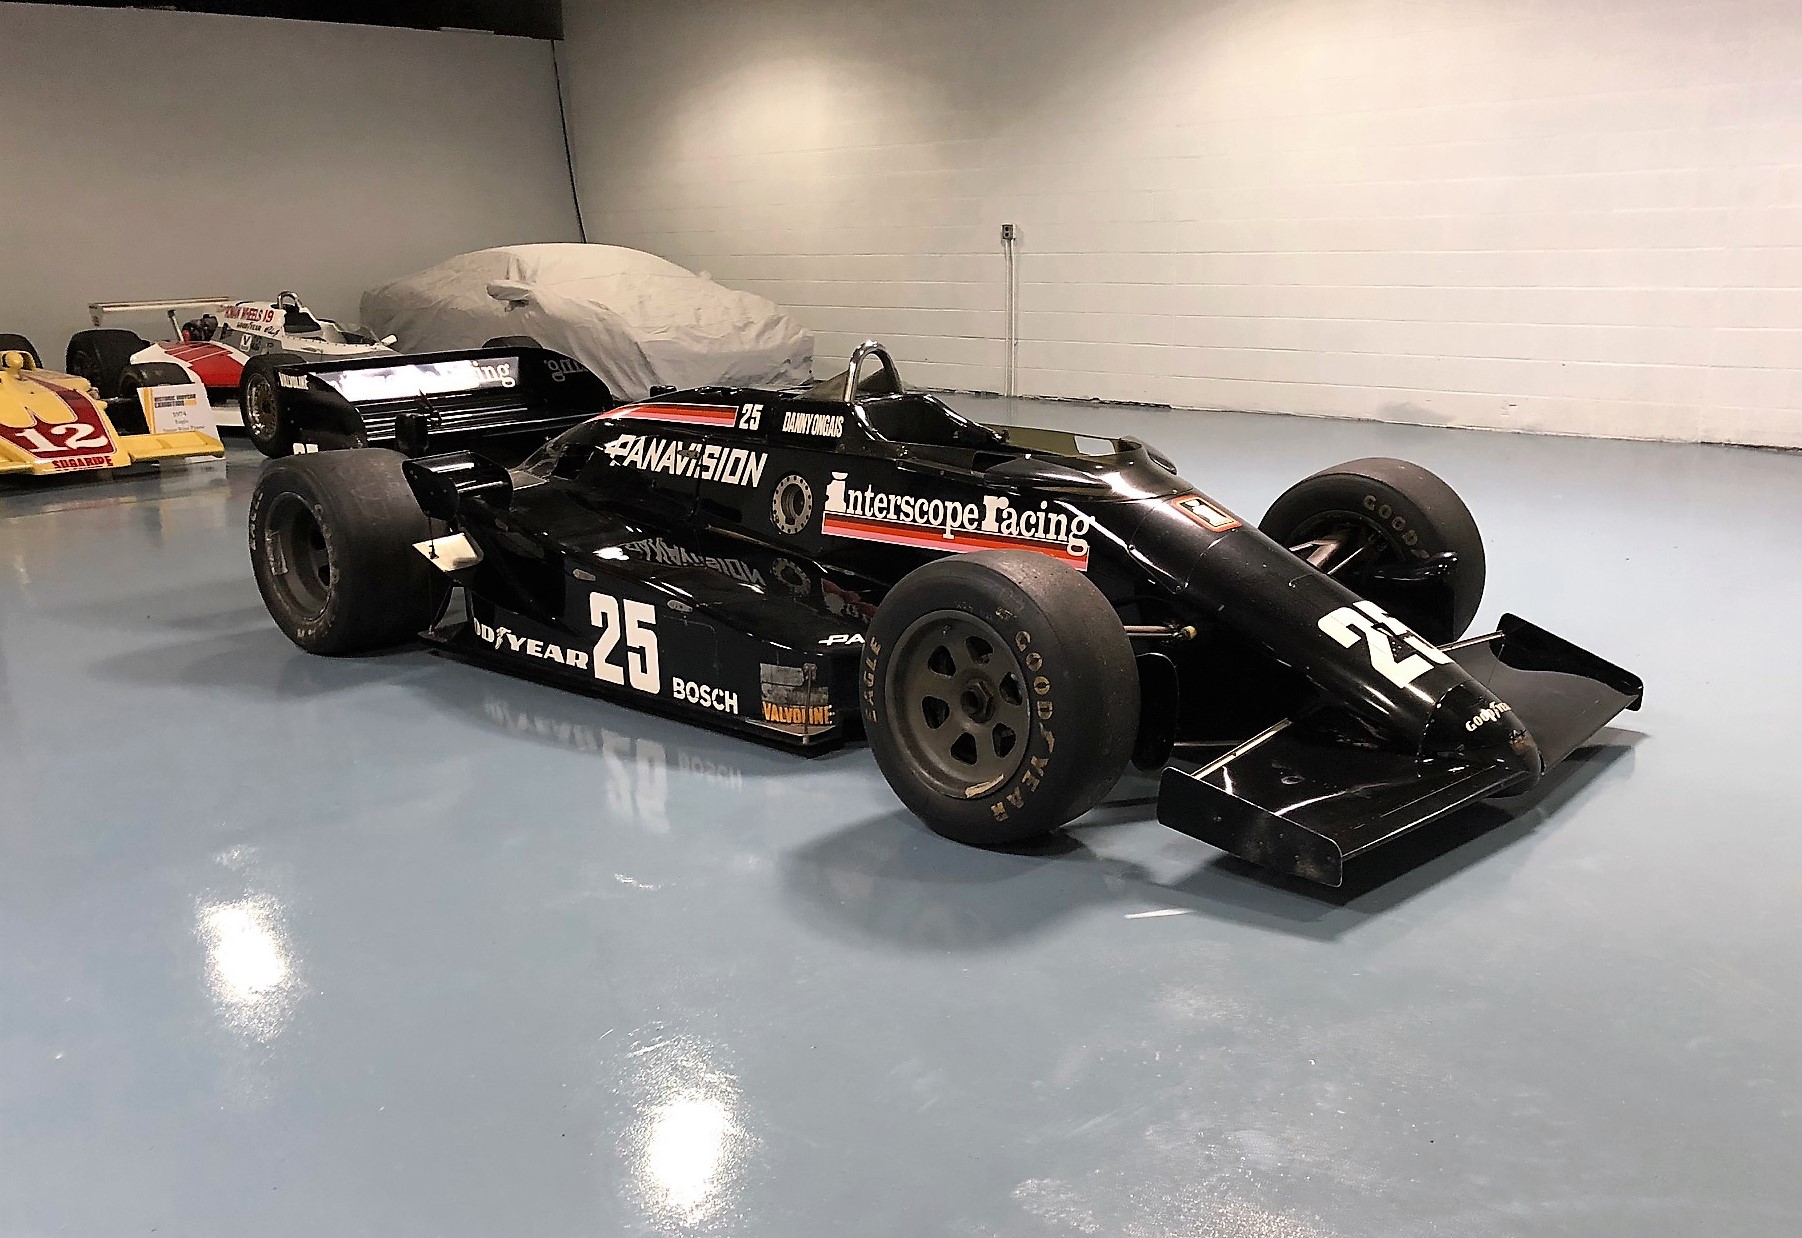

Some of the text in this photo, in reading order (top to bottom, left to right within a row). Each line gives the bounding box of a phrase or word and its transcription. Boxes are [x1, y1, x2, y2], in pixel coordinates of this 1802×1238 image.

[263, 309, 275, 323] 19
[738, 403, 764, 431] 25
[782, 411, 845, 438] DANNY ONGAIS
[15, 423, 109, 453] 12
[603, 434, 768, 488] PANAVISION
[589, 591, 661, 695] 25
[672, 676, 739, 715] BOSCH
[991, 630, 1056, 823] GOODYEAR
